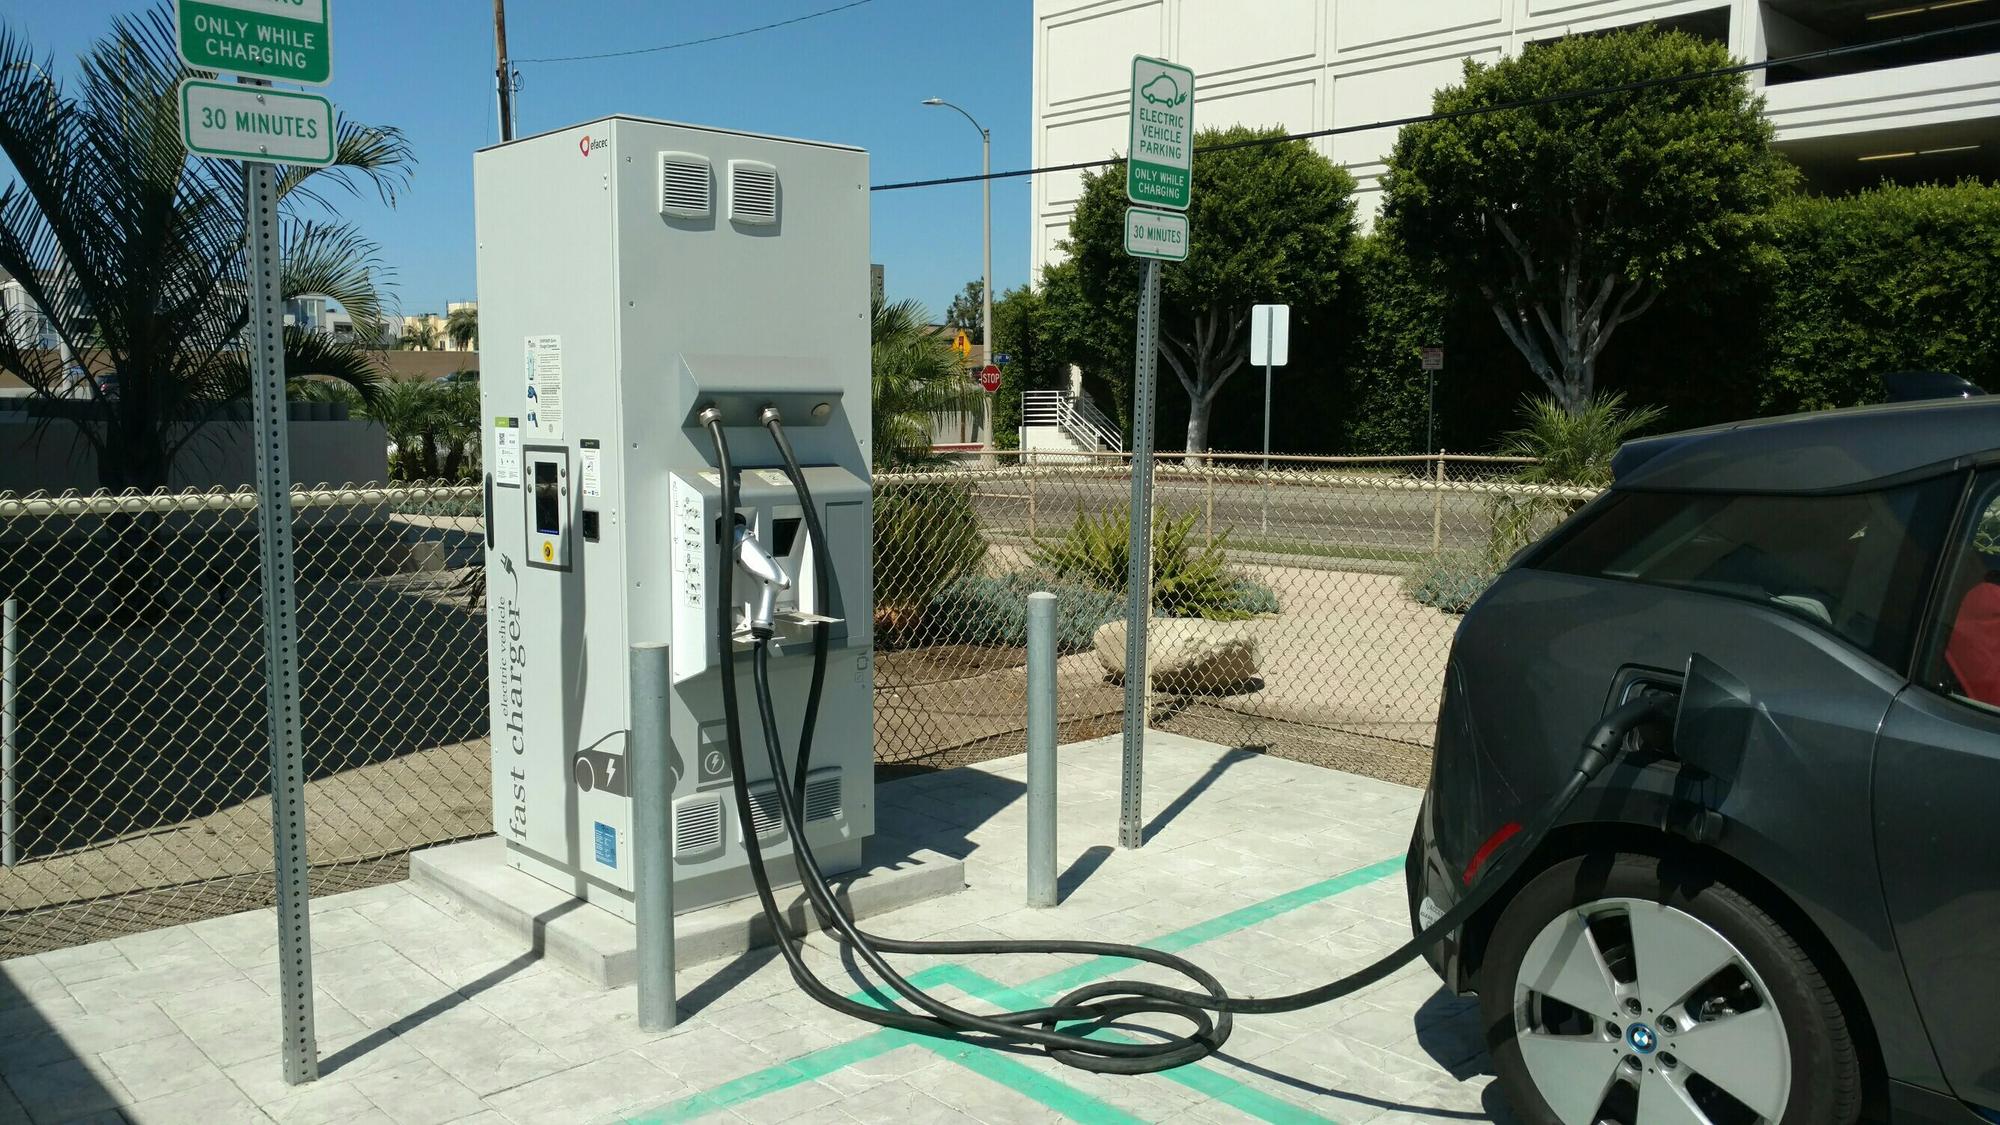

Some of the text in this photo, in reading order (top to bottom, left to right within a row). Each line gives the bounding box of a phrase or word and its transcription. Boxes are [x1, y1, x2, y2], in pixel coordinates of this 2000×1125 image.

[194, 15, 315, 49] ONLY WHILE
[205, 39, 307, 69] CHARGING
[202, 107, 317, 139] 30 MINUTES
[1140, 108, 1184, 129] ELECTRIC
[1142, 124, 1181, 144] VEHICLE
[591, 139, 607, 150] efacec
[1140, 140, 1182, 159] PARKING
[1135, 168, 1184, 187] ONLY WHILE
[1138, 182, 1180, 199] CHARGING
[1134, 225, 1181, 244] 30 MINUTES
[983, 373, 1000, 384] STOP
[498, 597, 509, 717] electric vehicle
[507, 600, 527, 840] fast charger
